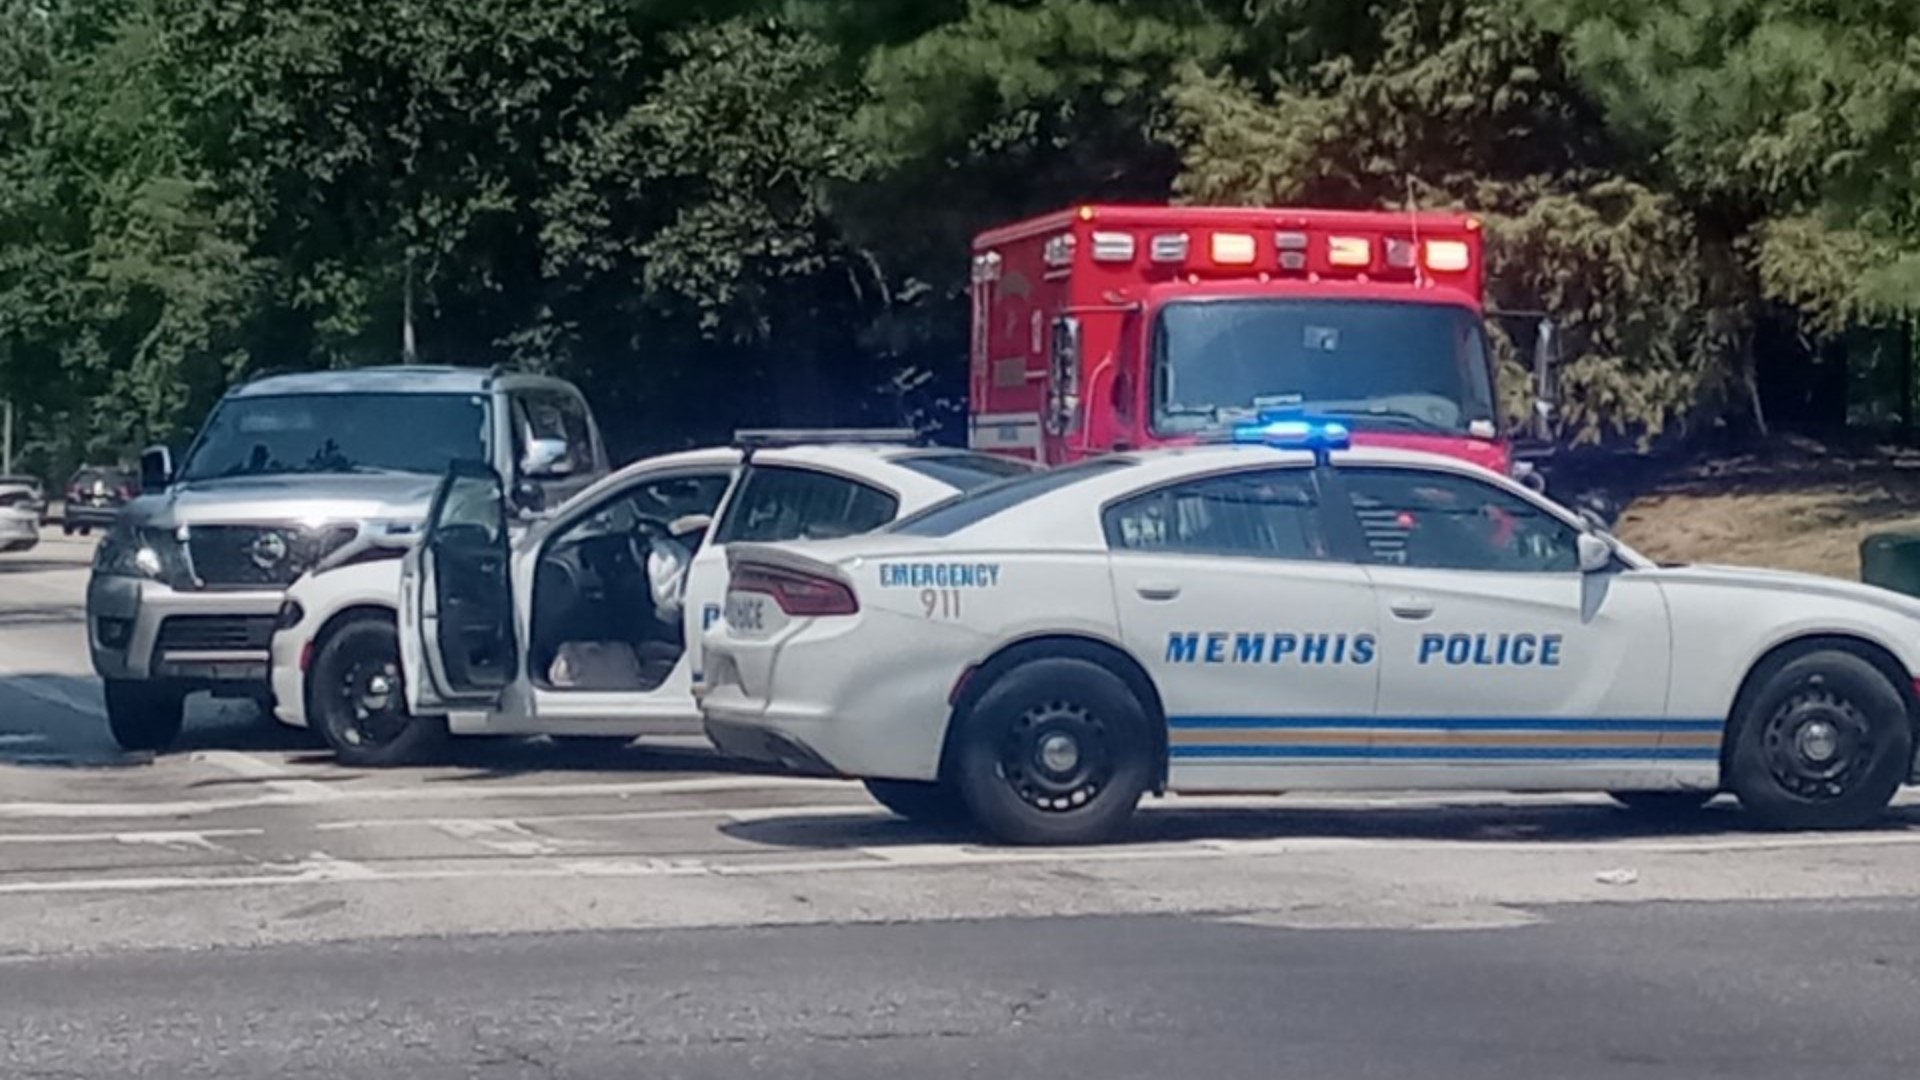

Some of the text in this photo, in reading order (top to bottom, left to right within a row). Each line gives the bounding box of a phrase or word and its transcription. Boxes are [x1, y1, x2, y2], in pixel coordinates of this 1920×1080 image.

[879, 562, 999, 588] EMERGENCY
[920, 588, 960, 619] 911
[1165, 632, 1563, 665] MEMPHIS POLICE
